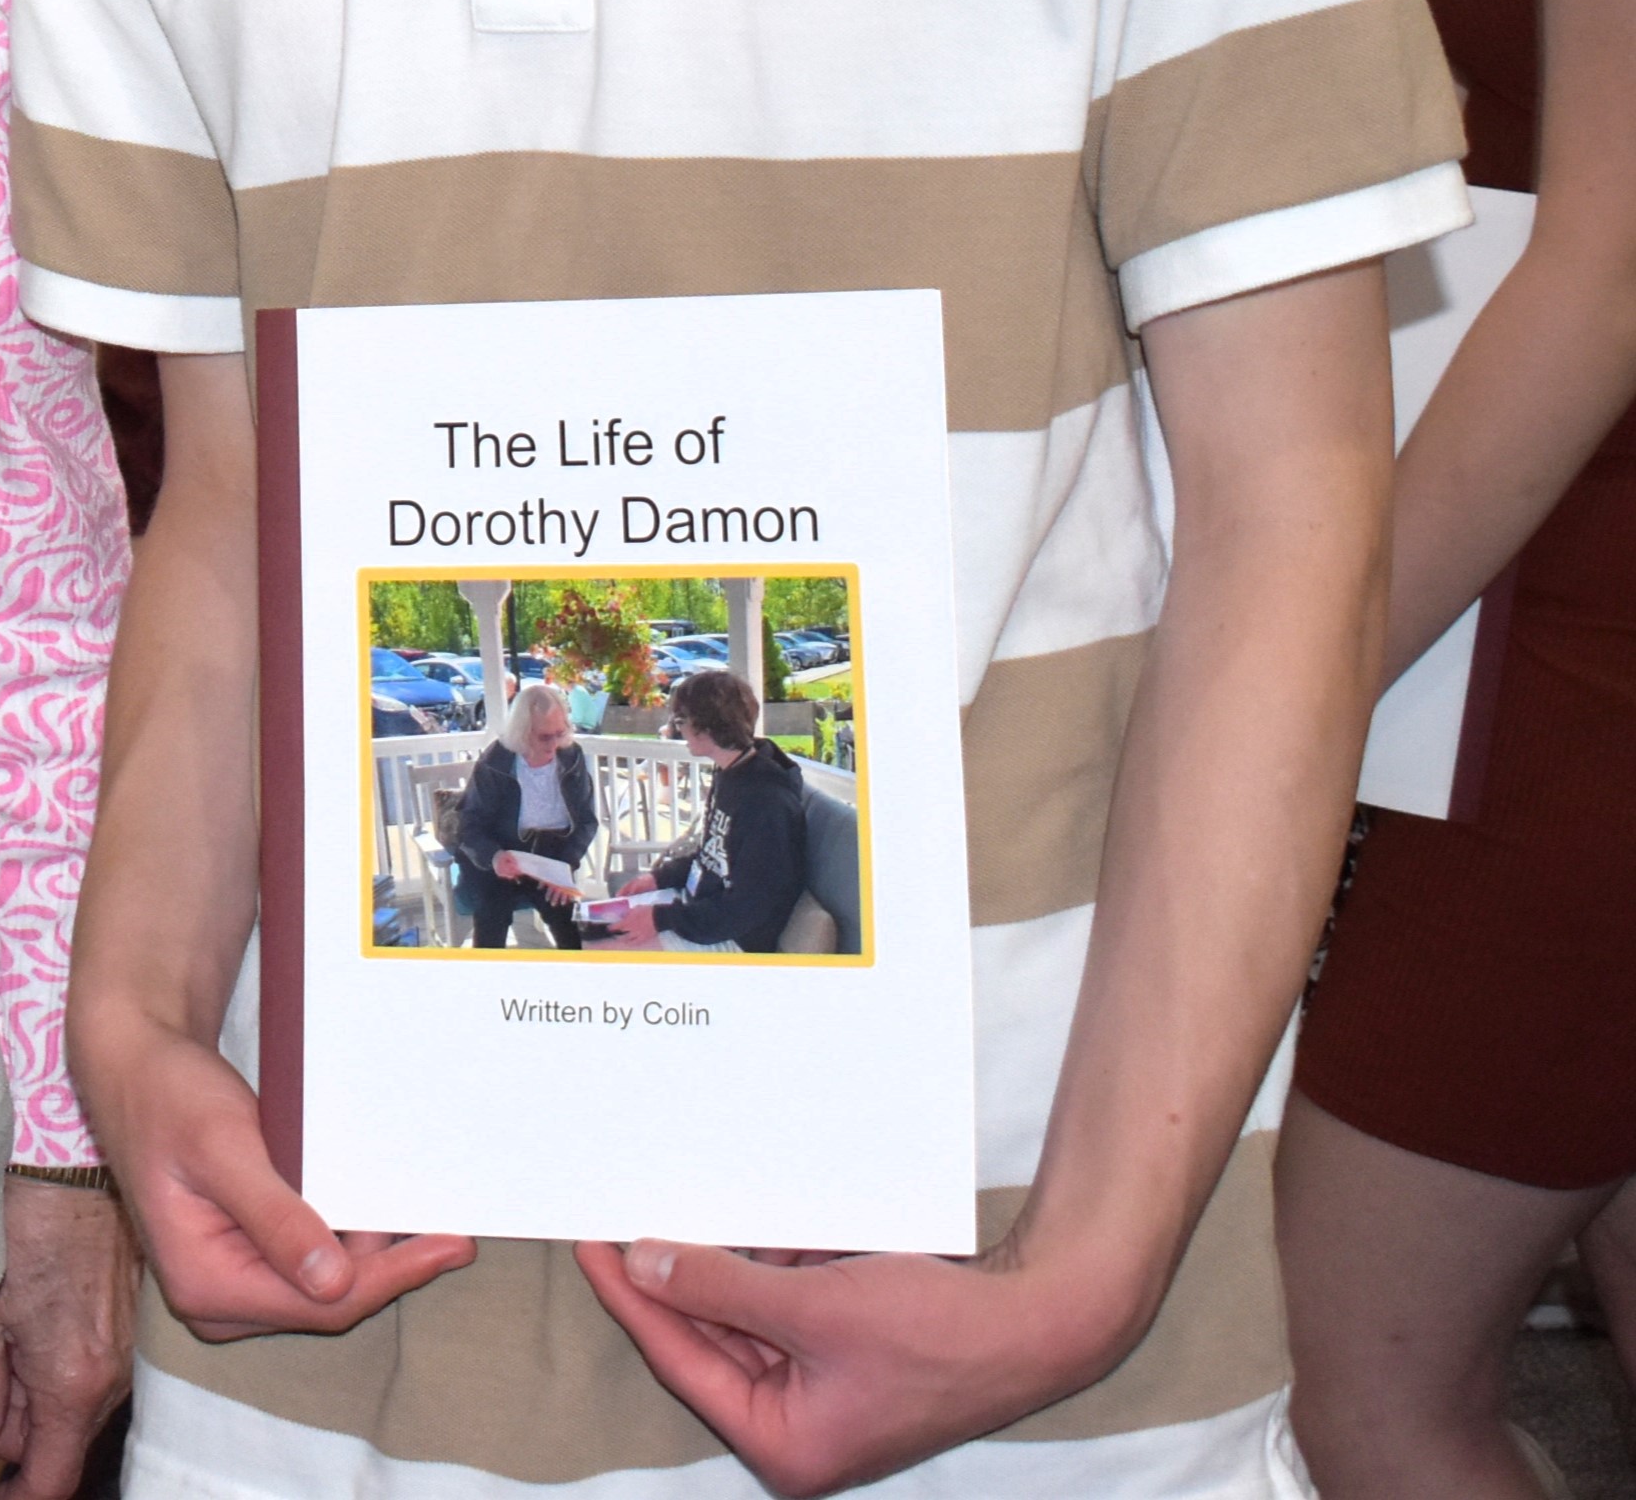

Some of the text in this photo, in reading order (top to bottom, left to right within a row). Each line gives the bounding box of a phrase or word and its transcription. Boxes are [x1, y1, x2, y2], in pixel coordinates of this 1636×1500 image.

[434, 415, 726, 469] The Life of
[389, 496, 820, 558] Dorothy Damon
[500, 998, 711, 1030] Written by Colin
